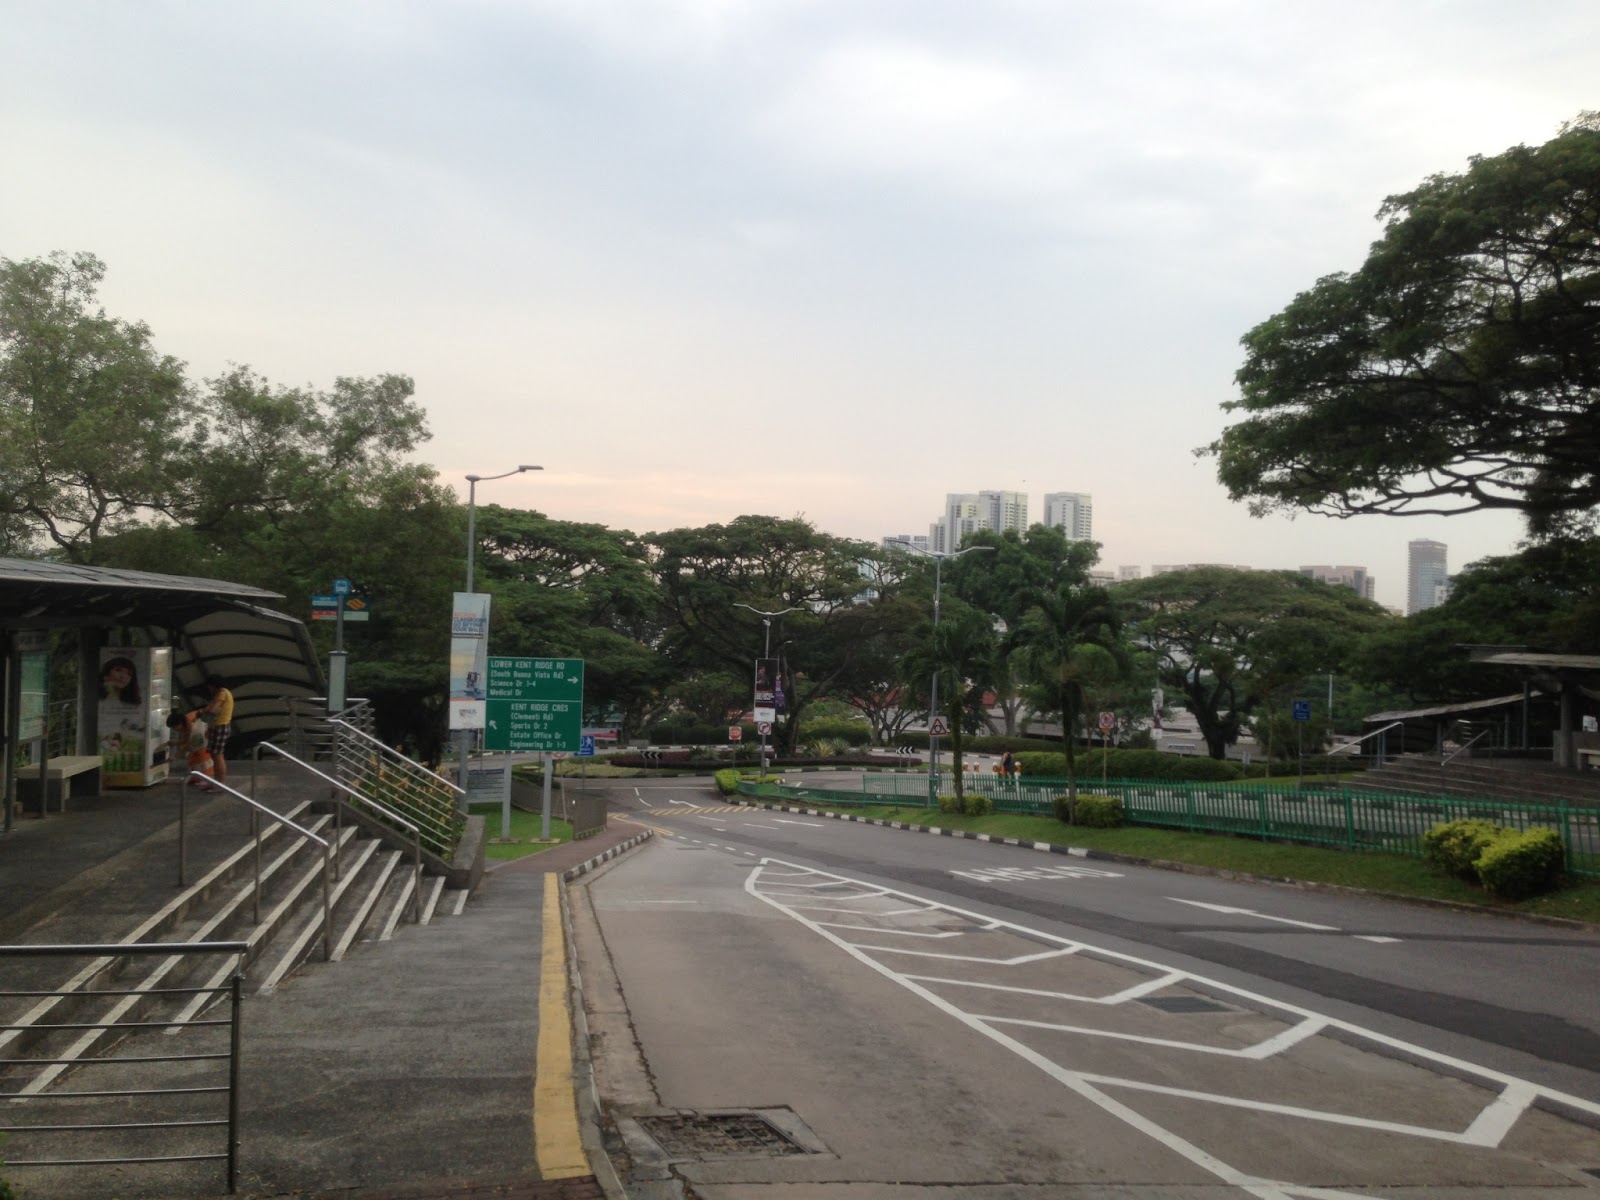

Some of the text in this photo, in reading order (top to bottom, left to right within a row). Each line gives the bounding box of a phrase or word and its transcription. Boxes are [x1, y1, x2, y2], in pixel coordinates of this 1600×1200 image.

[490, 660, 513, 668] LOWER
[534, 661, 553, 669] RIDGE
[556, 662, 565, 670] RD
[490, 670, 511, 678] (South
[534, 671, 551, 679] Vista
[553, 672, 564, 680] Rd)
[490, 679, 513, 687] Science
[489, 688, 513, 696] Medical
[510, 703, 569, 712] KENT RIDGE CRES
[510, 712, 554, 721] (Clementi Rd)
[510, 722, 531, 730] Sports
[533, 722, 541, 730] Dr
[509, 731, 530, 739] Estate
[533, 731, 552, 739] Office
[509, 740, 544, 749] Engineering
[948, 866, 1126, 883] AHEAD
